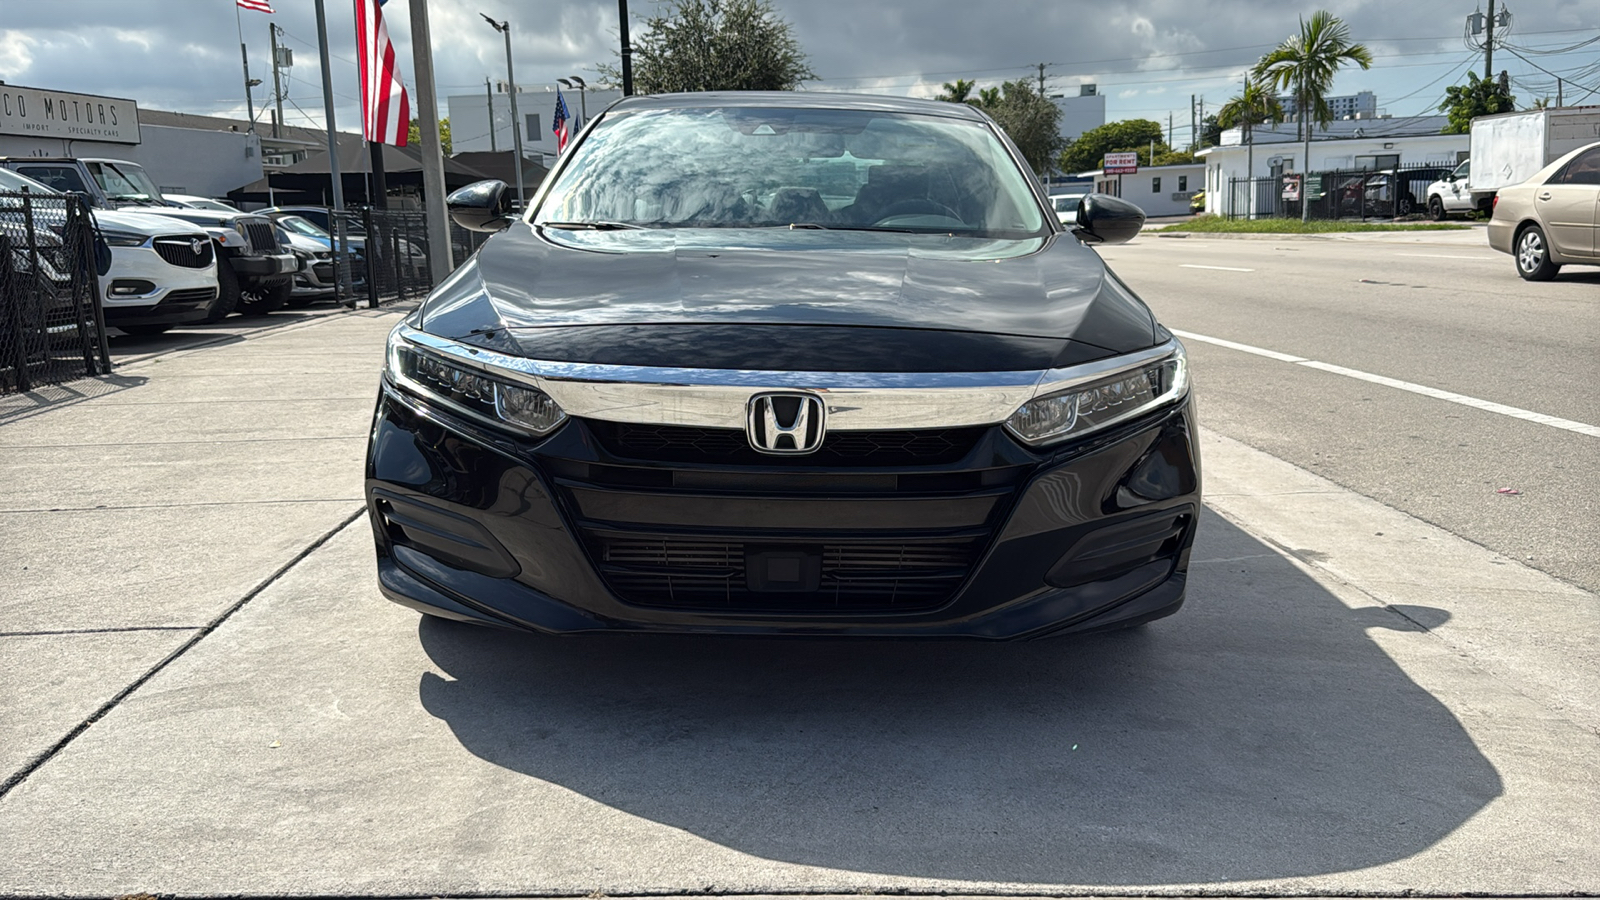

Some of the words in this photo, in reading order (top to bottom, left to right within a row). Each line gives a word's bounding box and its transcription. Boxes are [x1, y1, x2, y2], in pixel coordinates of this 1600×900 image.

[44, 98, 118, 126] MOTORS
[23, 123, 49, 132] IMPORT
[68, 126, 101, 136] SPECIALTY
[103, 129, 119, 137] CARS
